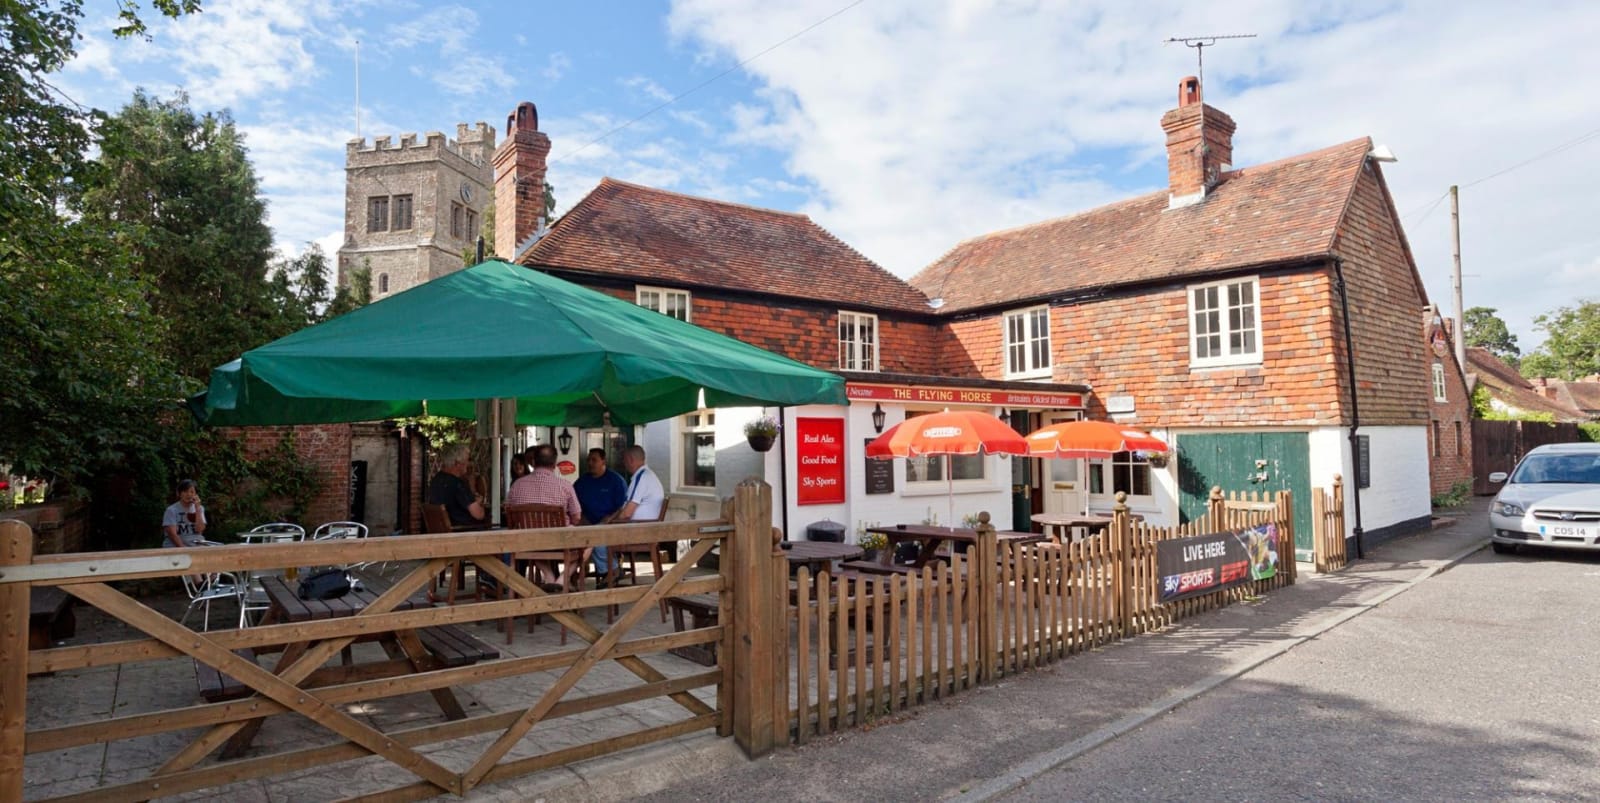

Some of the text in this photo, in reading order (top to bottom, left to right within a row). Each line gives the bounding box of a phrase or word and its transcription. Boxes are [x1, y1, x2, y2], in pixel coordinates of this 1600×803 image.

[893, 388, 992, 402] THE FLYING HORSE
[804, 434, 835, 443] Real Ales
[802, 455, 837, 464] Good Food
[803, 476, 837, 488] Sky Sports
[1183, 541, 1226, 562] LIVE HERE
[1164, 570, 1214, 593] sky SPORTS
